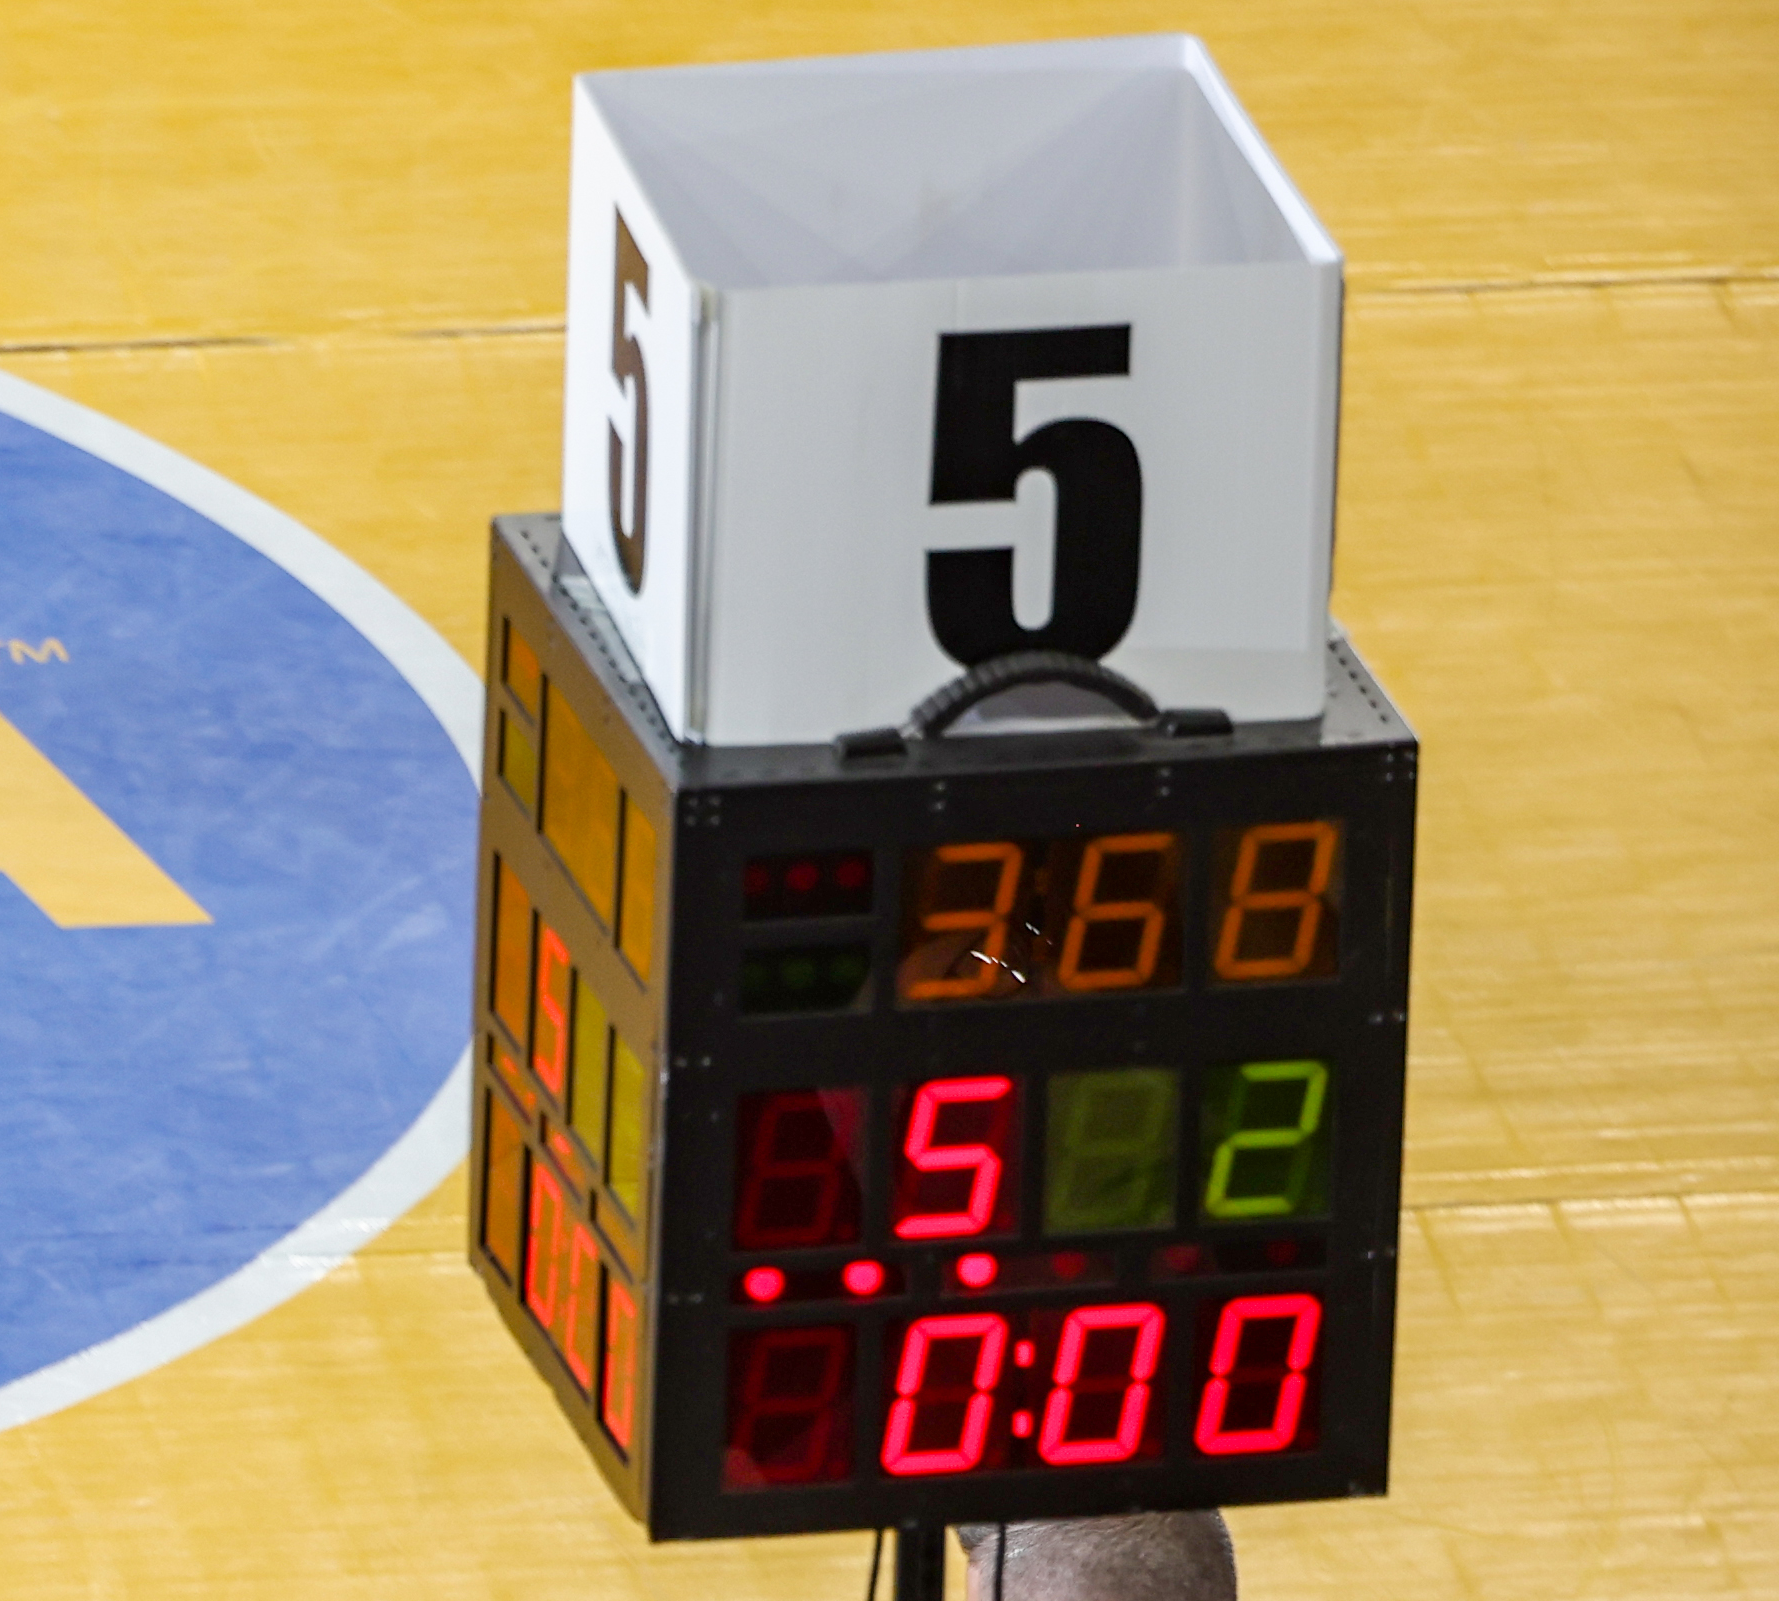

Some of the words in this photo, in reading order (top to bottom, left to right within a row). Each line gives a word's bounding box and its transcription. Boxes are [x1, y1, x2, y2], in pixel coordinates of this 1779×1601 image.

[606, 200, 652, 600] 5
[923, 322, 1144, 672] 5
[532, 925, 570, 1095] 5
[895, 1074, 1013, 1242] 5
[1204, 1059, 1328, 1219] 2
[879, 1292, 1323, 1477] 0:00
